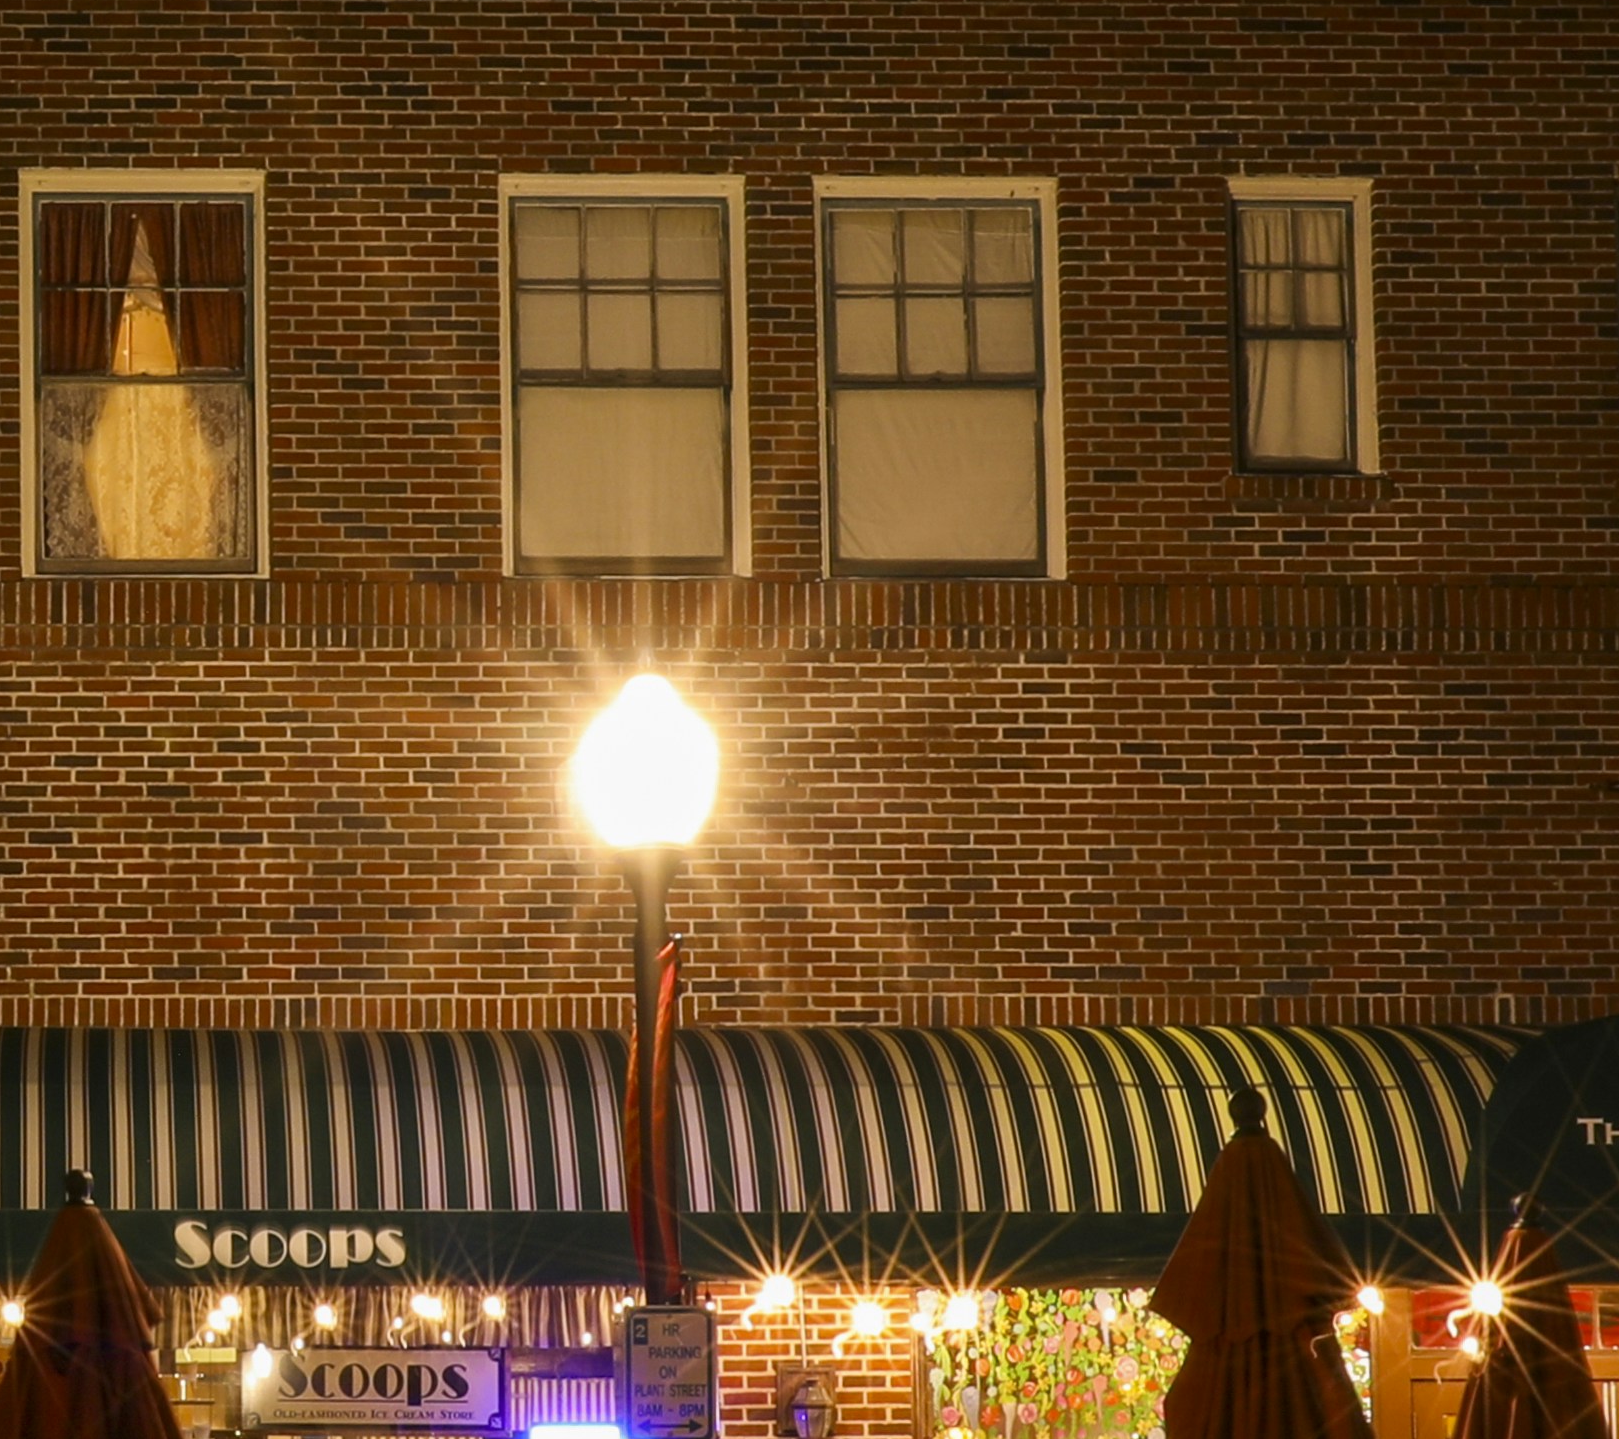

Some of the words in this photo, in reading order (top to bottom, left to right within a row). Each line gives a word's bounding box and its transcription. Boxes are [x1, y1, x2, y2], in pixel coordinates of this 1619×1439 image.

[635, 1323, 646, 1338] 2
[662, 1324, 680, 1336] HR
[648, 1346, 701, 1359] PARKING
[658, 1365, 677, 1379] ON
[634, 1384, 664, 1397] PLANT
[669, 1383, 706, 1397] STREET
[637, 1404, 662, 1417] 8AM
[679, 1404, 704, 1417] 8PM
